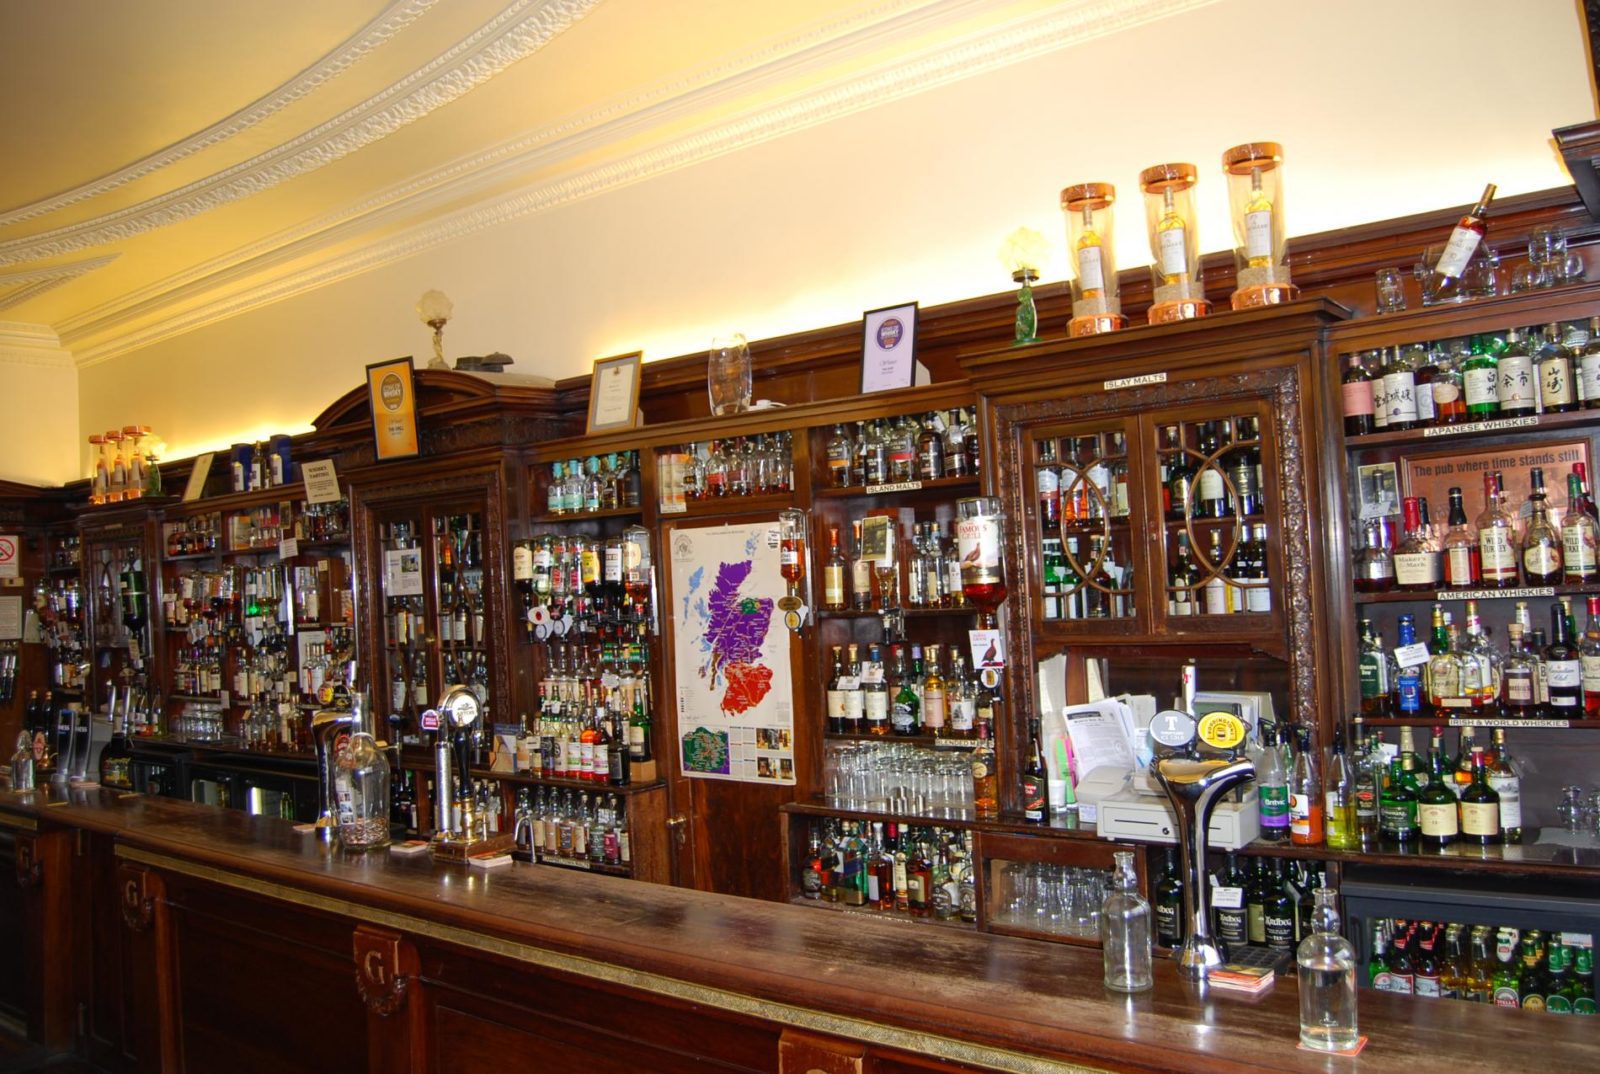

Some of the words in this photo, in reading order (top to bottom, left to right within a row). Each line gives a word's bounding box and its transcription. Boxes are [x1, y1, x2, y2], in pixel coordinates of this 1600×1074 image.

[1106, 379, 1131, 389] ISLAY
[1133, 374, 1165, 384] MALTS
[1426, 423, 1480, 436] JAPANESE
[1483, 417, 1537, 430] WHISKIES
[1415, 466, 1432, 477] The
[1435, 463, 1454, 476] pub
[1457, 460, 1489, 472] where
[1492, 457, 1516, 469] time
[1519, 453, 1555, 466] stands
[1558, 450, 1579, 462] still
[868, 484, 895, 493] ISLAND
[896, 481, 921, 490] MALTS
[1440, 591, 1496, 600] AMERICAN
[1500, 587, 1553, 598] WHISKIES
[1164, 716, 1178, 731] T
[1485, 719, 1519, 727] WORLD
[1522, 720, 1568, 728] WHISKIES
[364, 950, 385, 985] G
